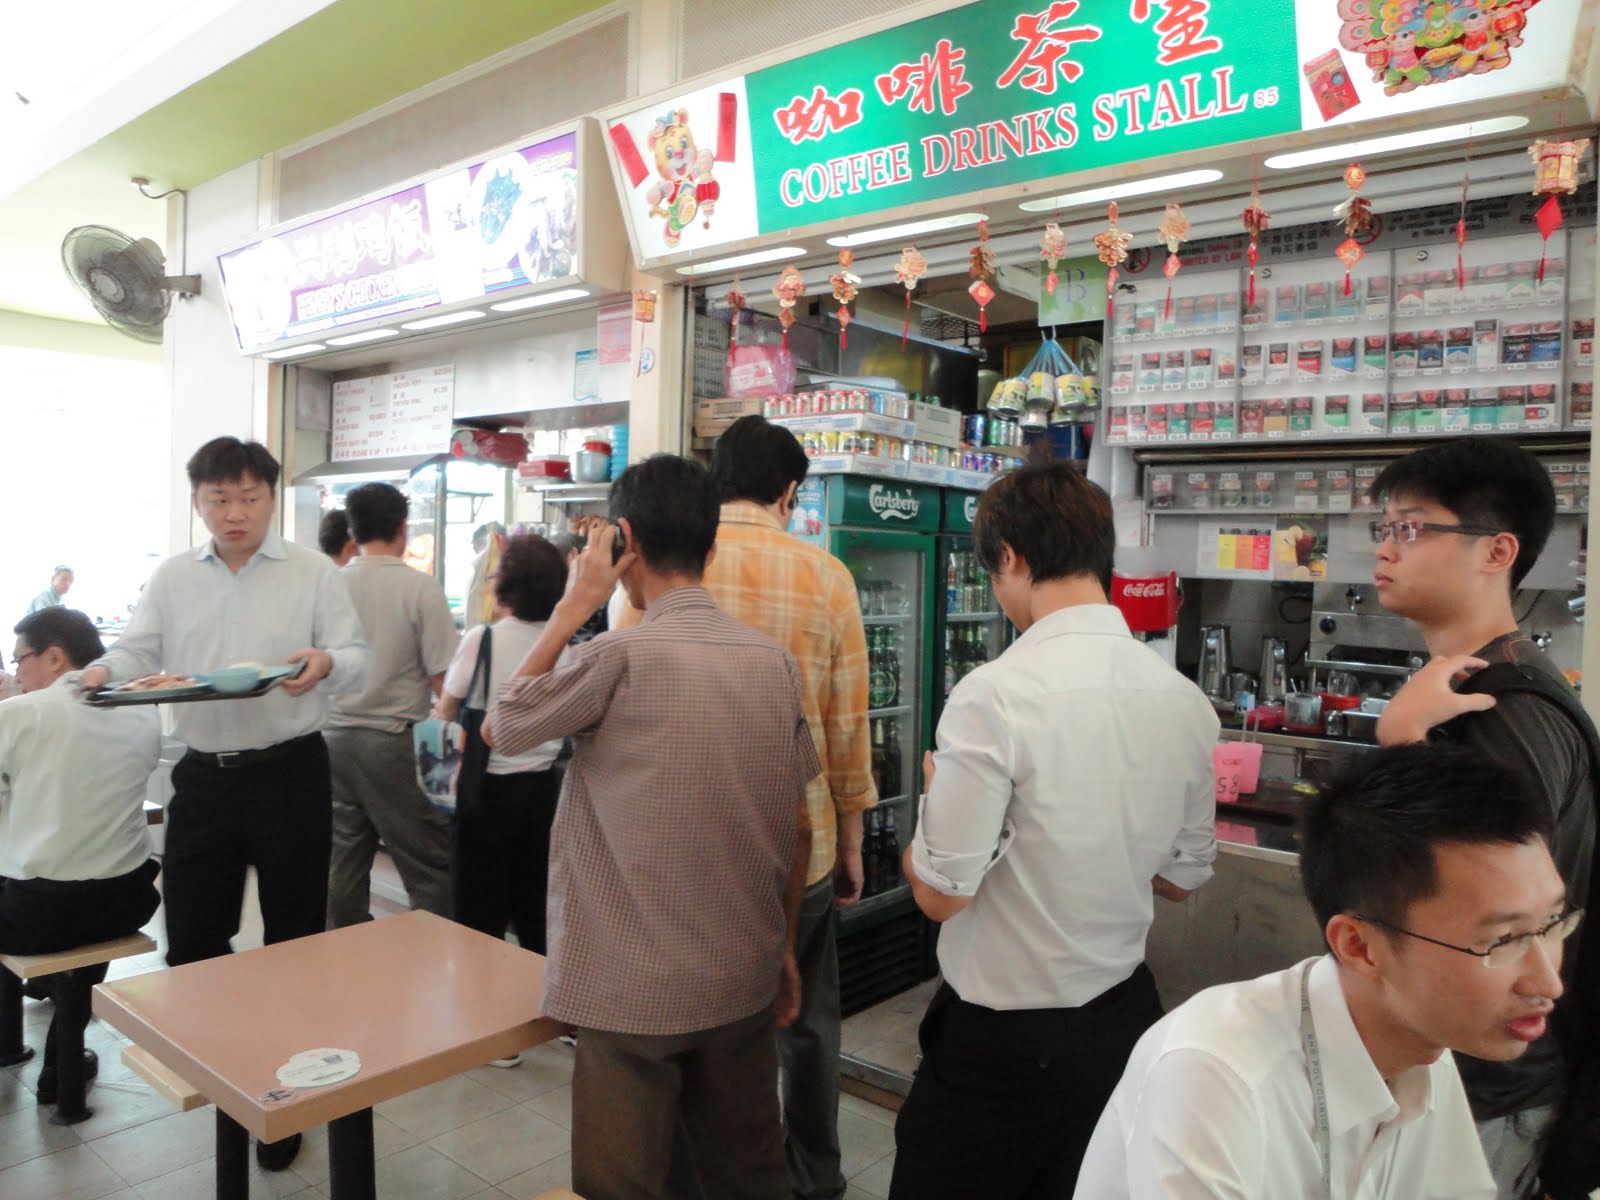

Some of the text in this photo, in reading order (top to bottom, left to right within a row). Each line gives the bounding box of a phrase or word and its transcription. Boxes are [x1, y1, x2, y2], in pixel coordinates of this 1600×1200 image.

[780, 65, 1280, 208] COFFEE DRINKS STALL 85
[869, 484, 920, 520] Carlsberg
